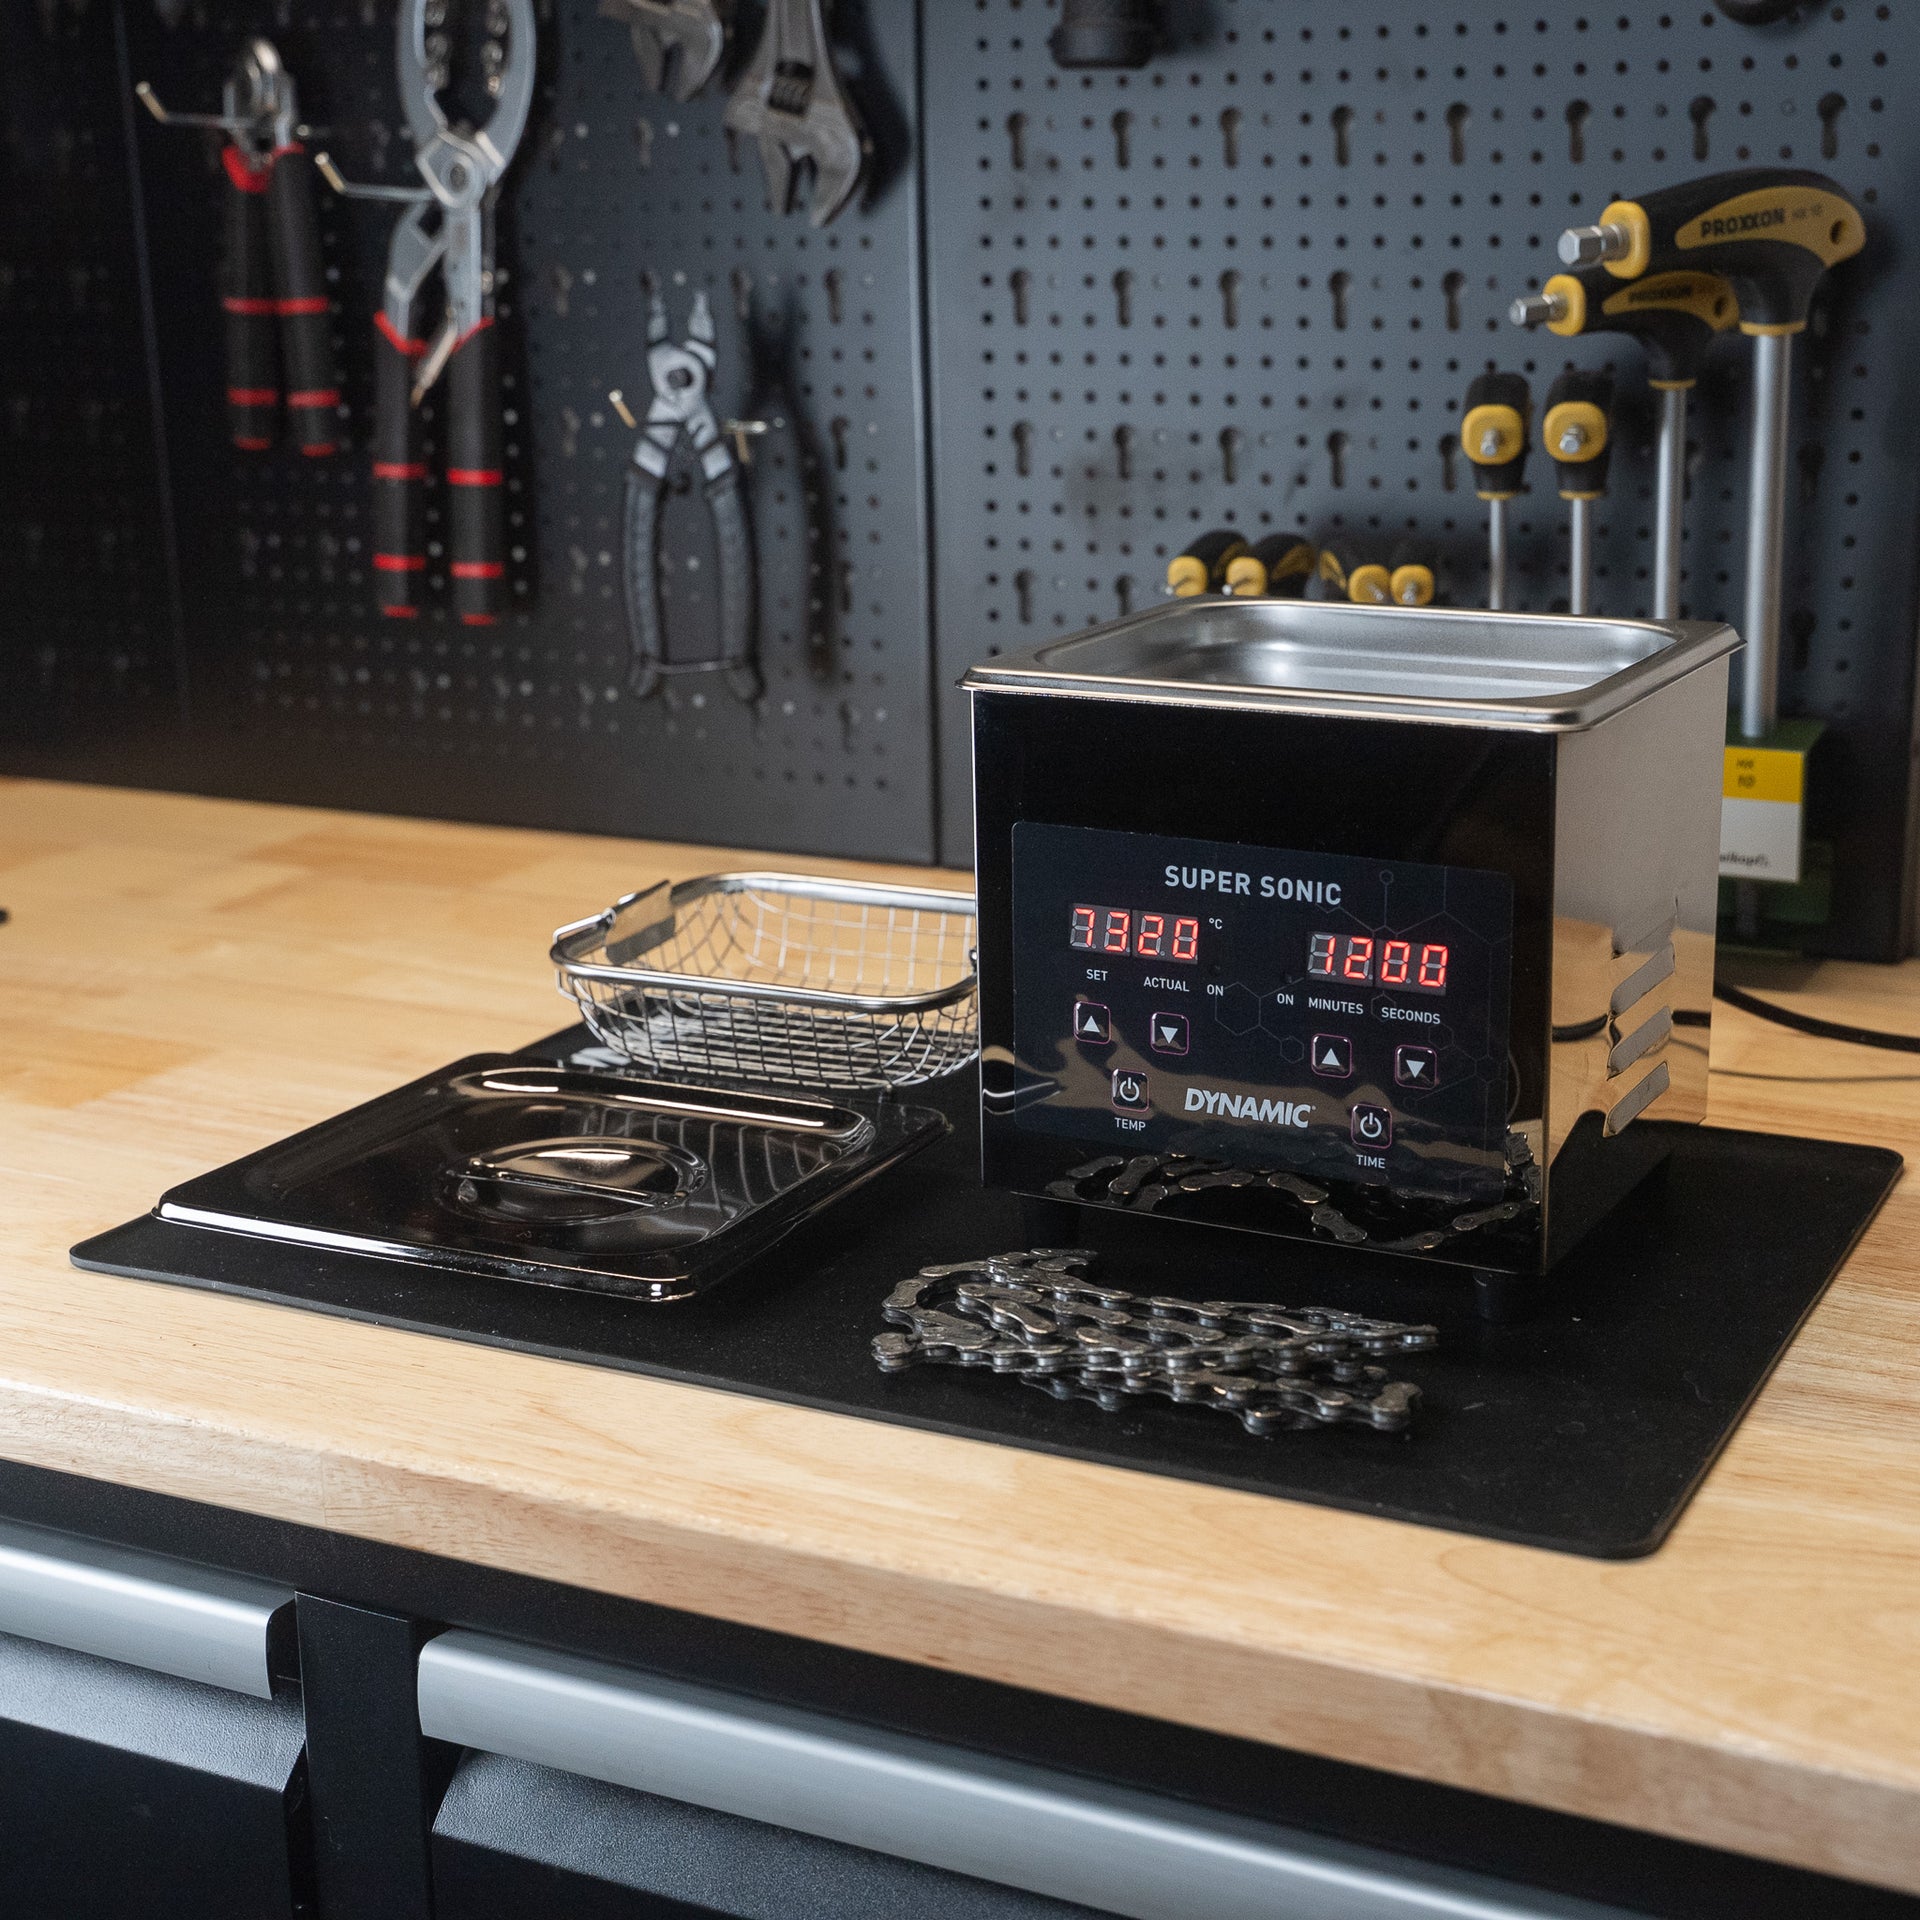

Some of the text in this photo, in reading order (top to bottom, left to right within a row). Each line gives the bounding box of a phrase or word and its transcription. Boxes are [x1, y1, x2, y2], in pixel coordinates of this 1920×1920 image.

[1701, 208, 1785, 238] PROXXON
[1164, 865, 1342, 905] SUPER SONIC
[1208, 917, 1223, 930] °C
[1086, 969, 1224, 997] SET ACTUAL ON
[1276, 993, 1441, 1025] ON MINUTES SECONDS
[1184, 1087, 1312, 1128] DYNAMIC
[1114, 1118, 1146, 1132] TEMP
[1356, 1154, 1386, 1169] TIME
